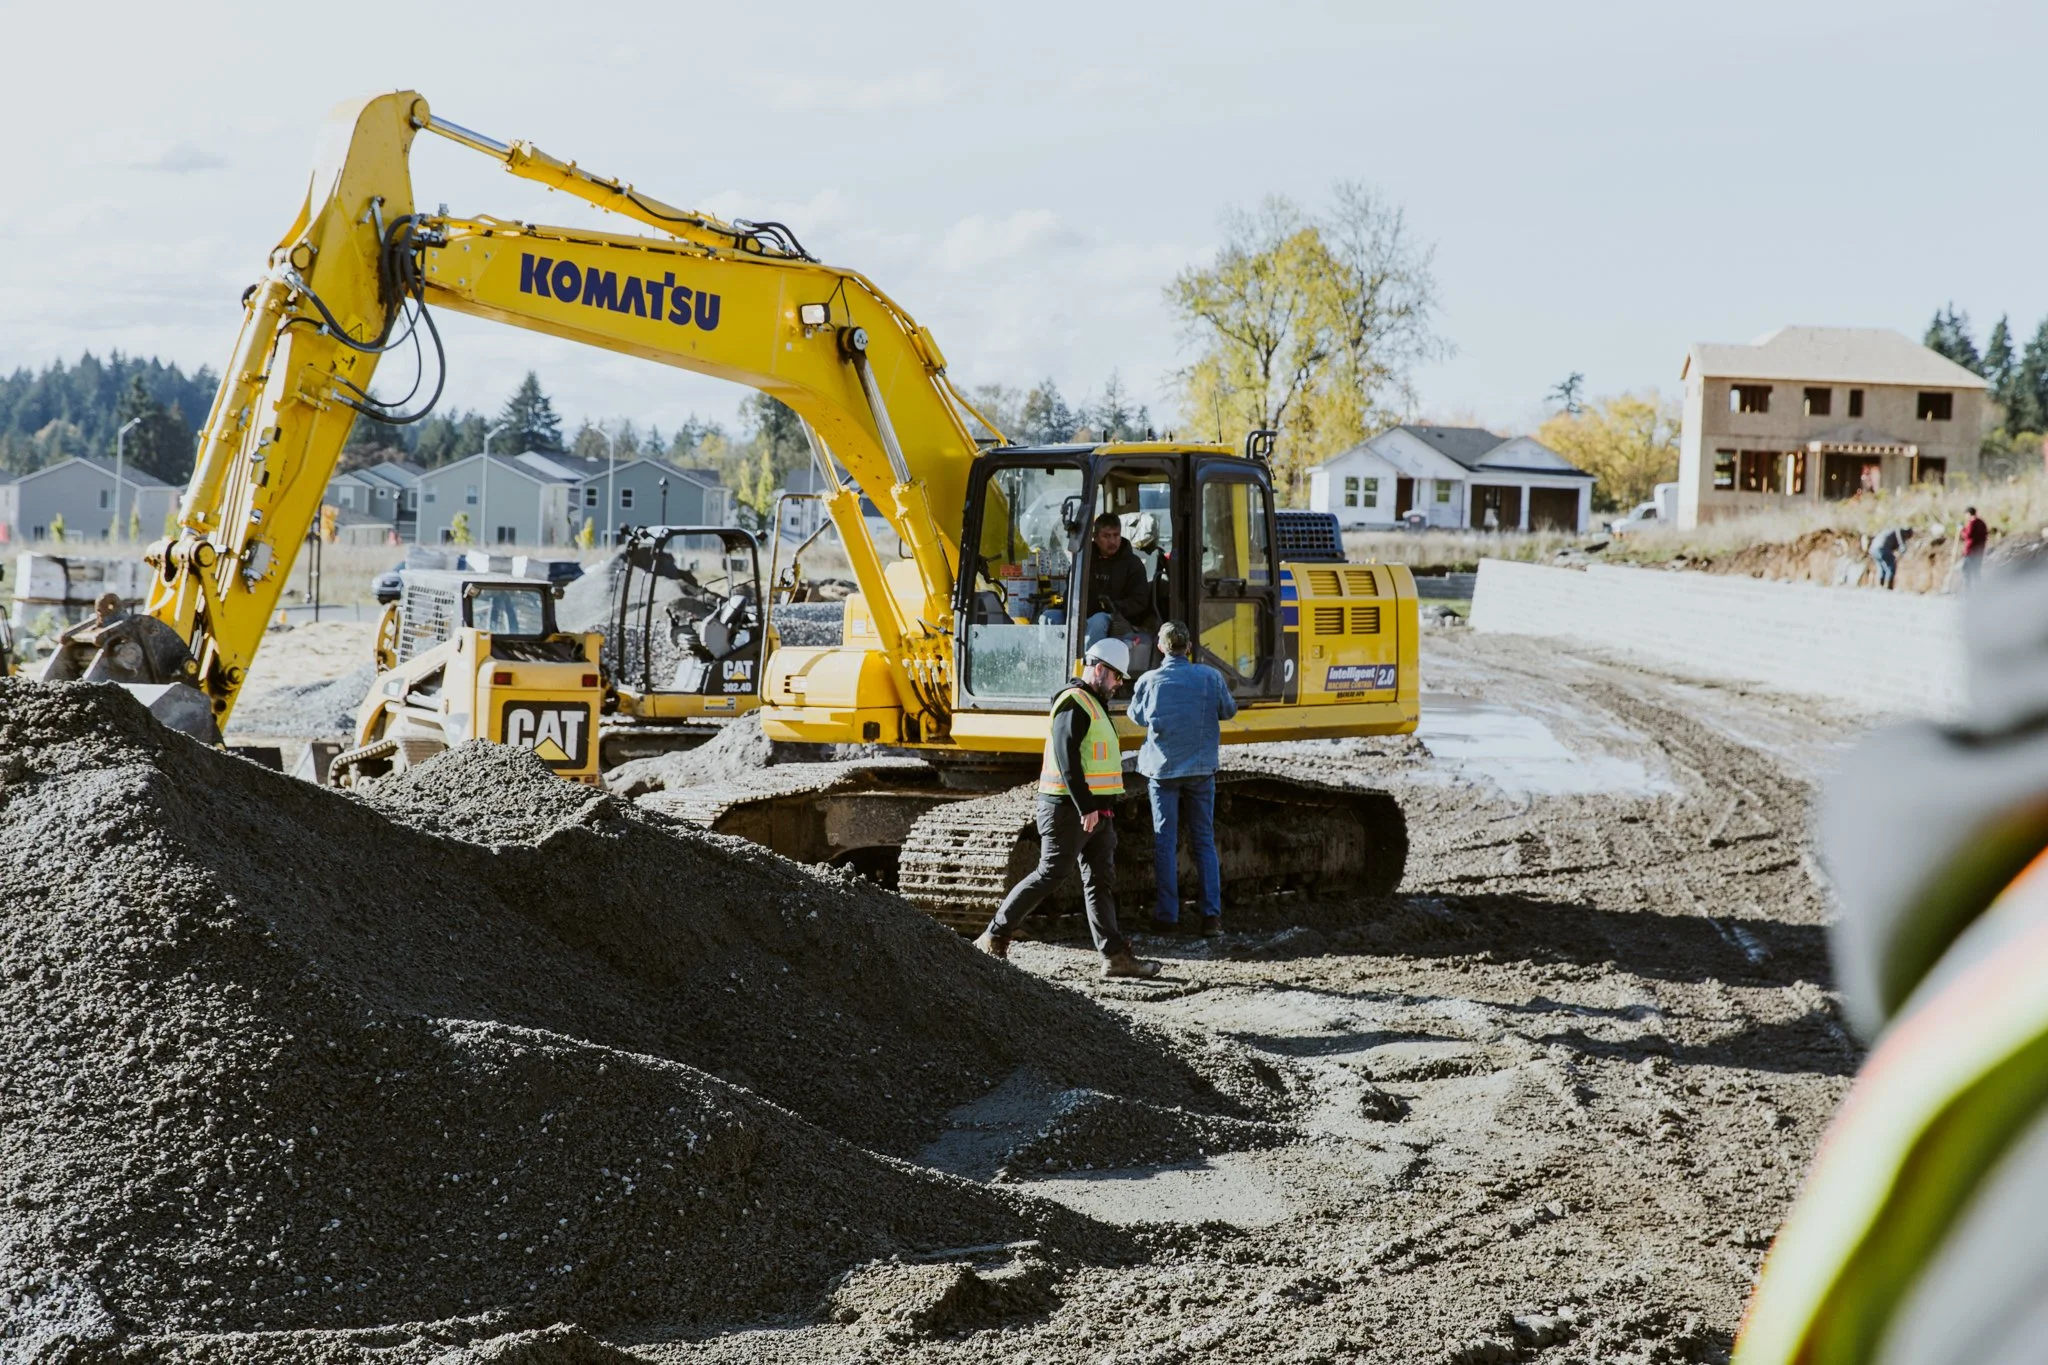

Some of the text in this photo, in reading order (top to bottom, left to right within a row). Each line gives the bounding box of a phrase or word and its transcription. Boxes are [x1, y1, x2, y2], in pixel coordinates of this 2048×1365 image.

[520, 253, 721, 331] KOMATSU
[723, 660, 753, 680] CAT
[1377, 668, 1395, 685] 2.0
[507, 708, 585, 761] CAT
